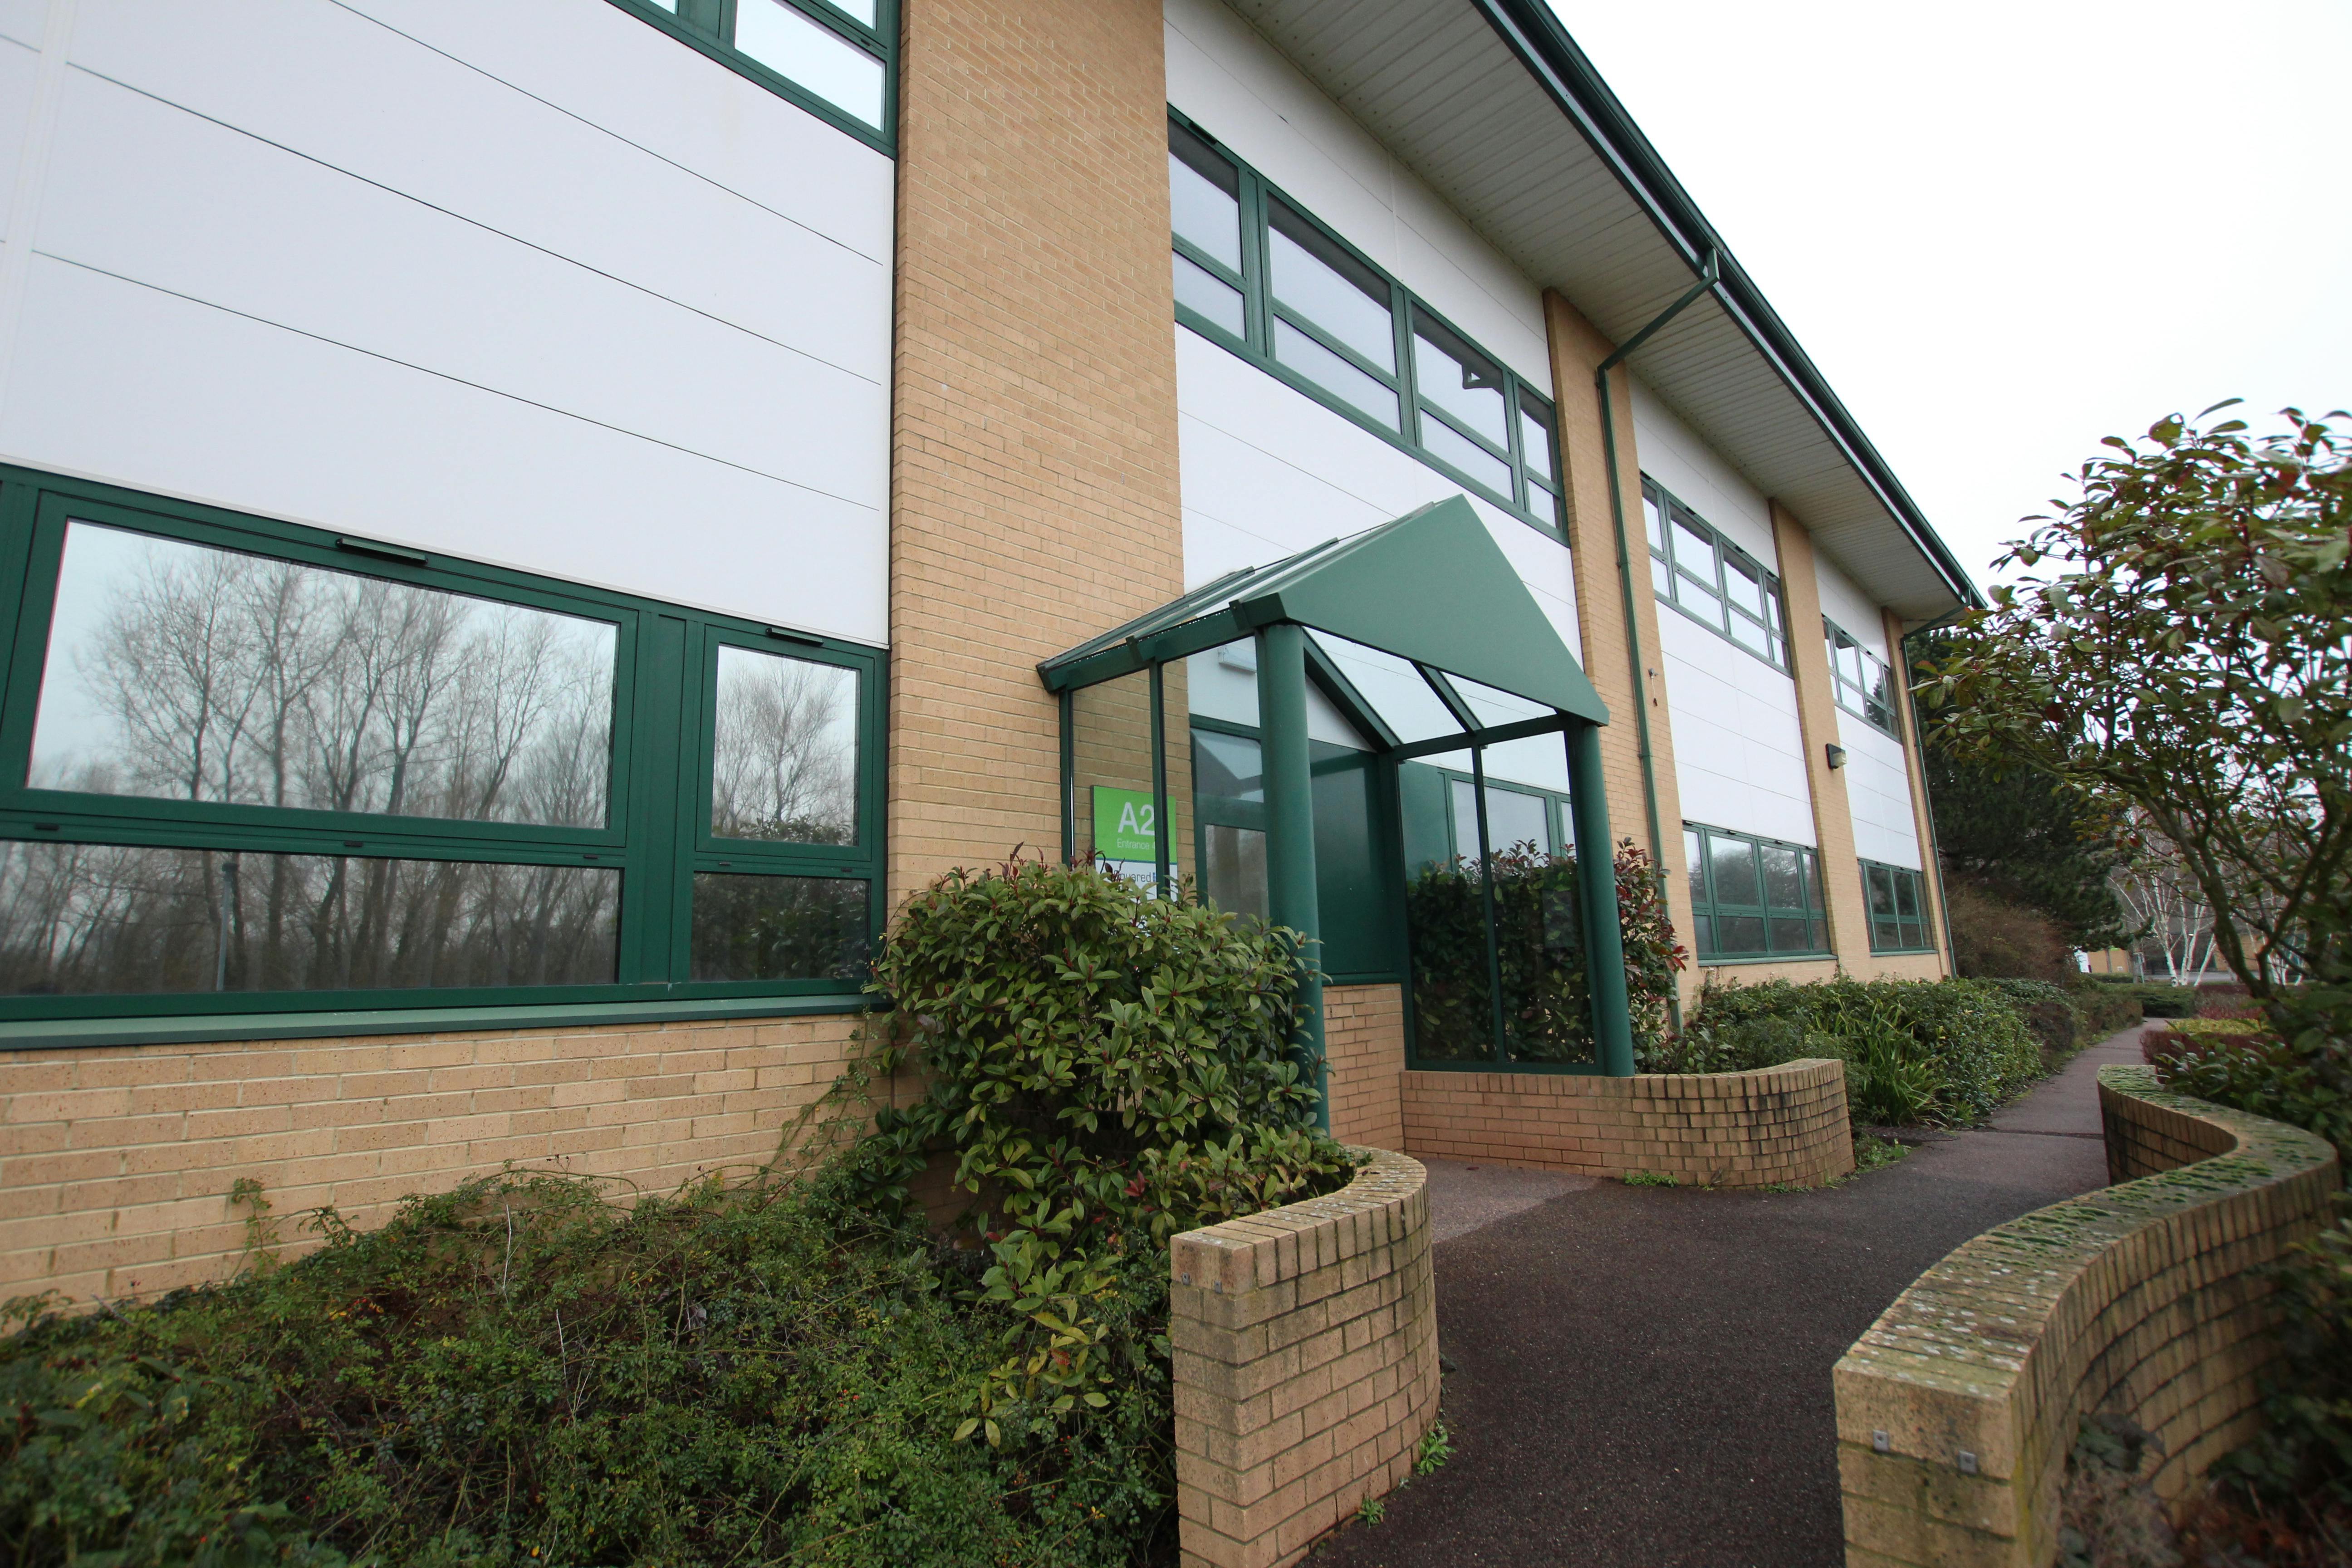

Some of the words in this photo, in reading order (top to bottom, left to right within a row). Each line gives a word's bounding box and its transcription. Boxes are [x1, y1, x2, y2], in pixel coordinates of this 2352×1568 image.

[1117, 801, 1155, 836] A2
[1117, 838, 1149, 850] Entrance
[1114, 870, 1151, 882] qared
